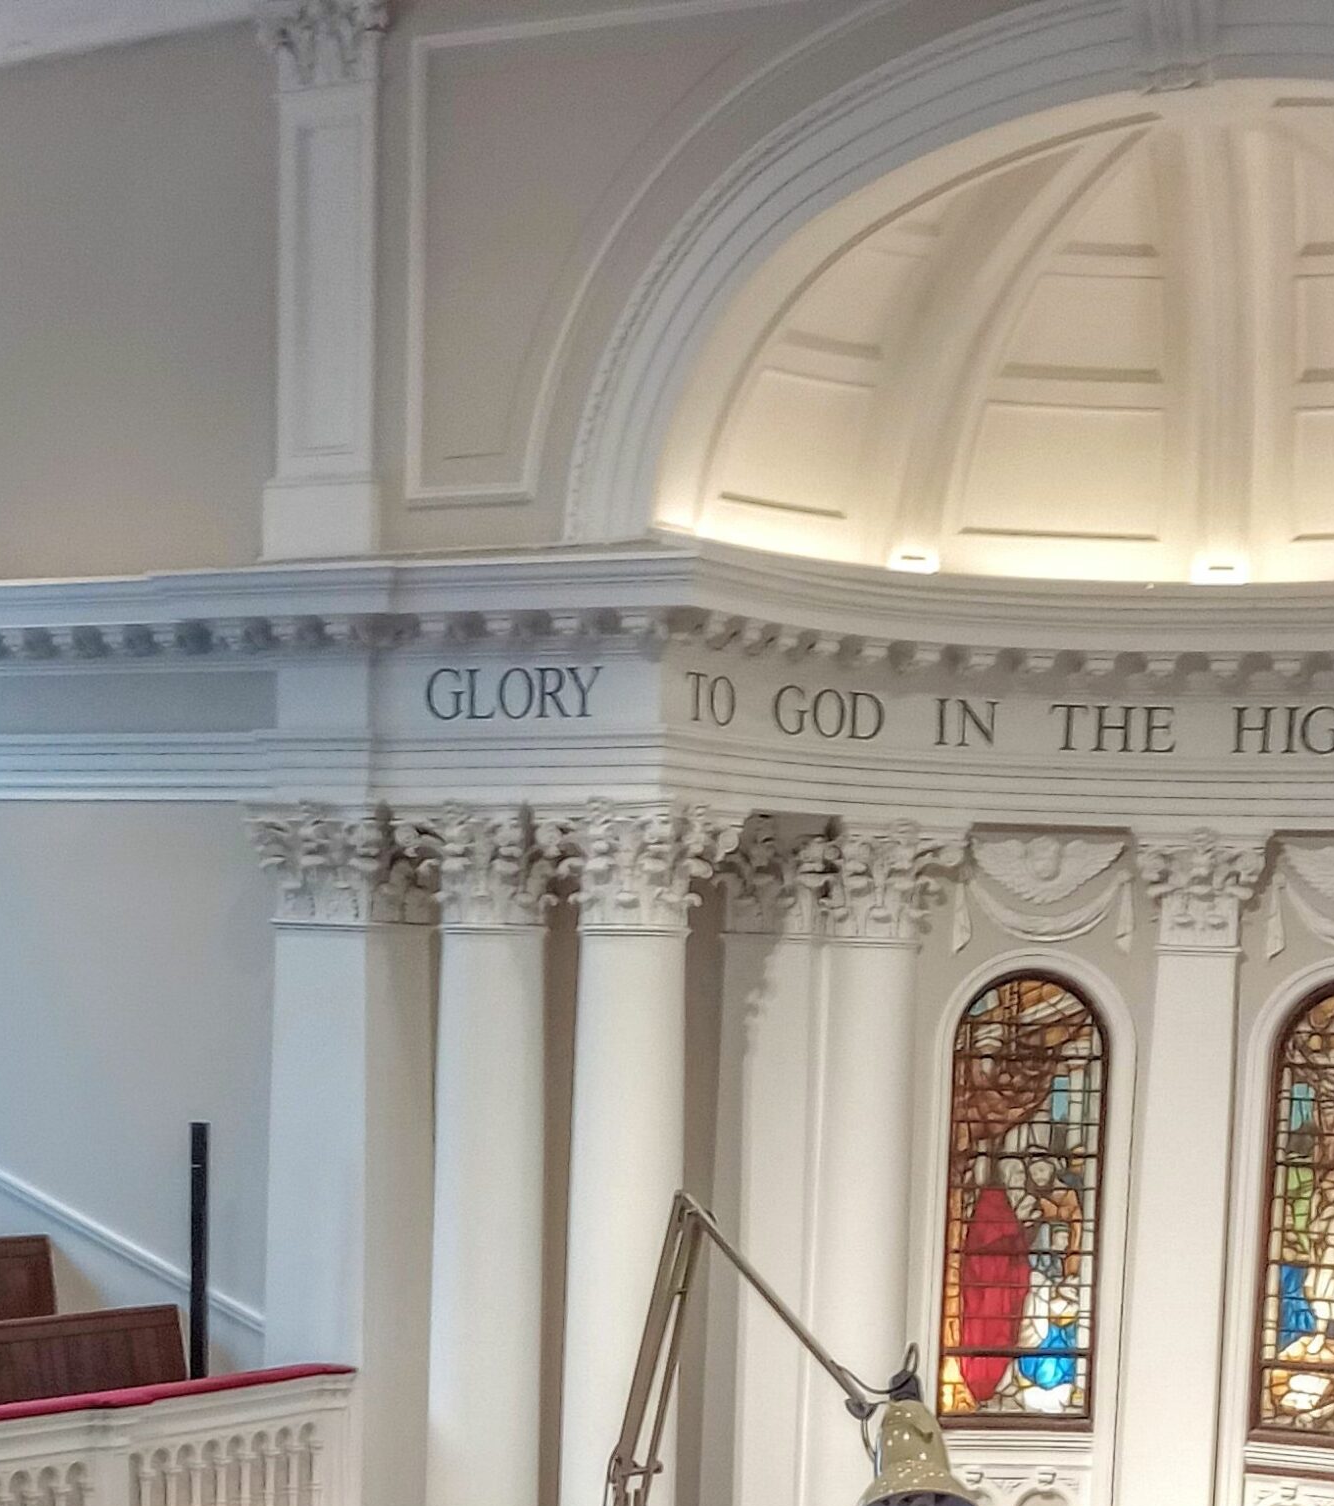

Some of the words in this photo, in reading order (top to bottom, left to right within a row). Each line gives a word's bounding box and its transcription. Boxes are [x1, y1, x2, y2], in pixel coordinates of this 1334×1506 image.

[425, 665, 603, 721] GLORY
[685, 671, 737, 727] TO
[773, 685, 885, 741] GOD
[934, 699, 1000, 746] IN
[1051, 703, 1176, 753] THE
